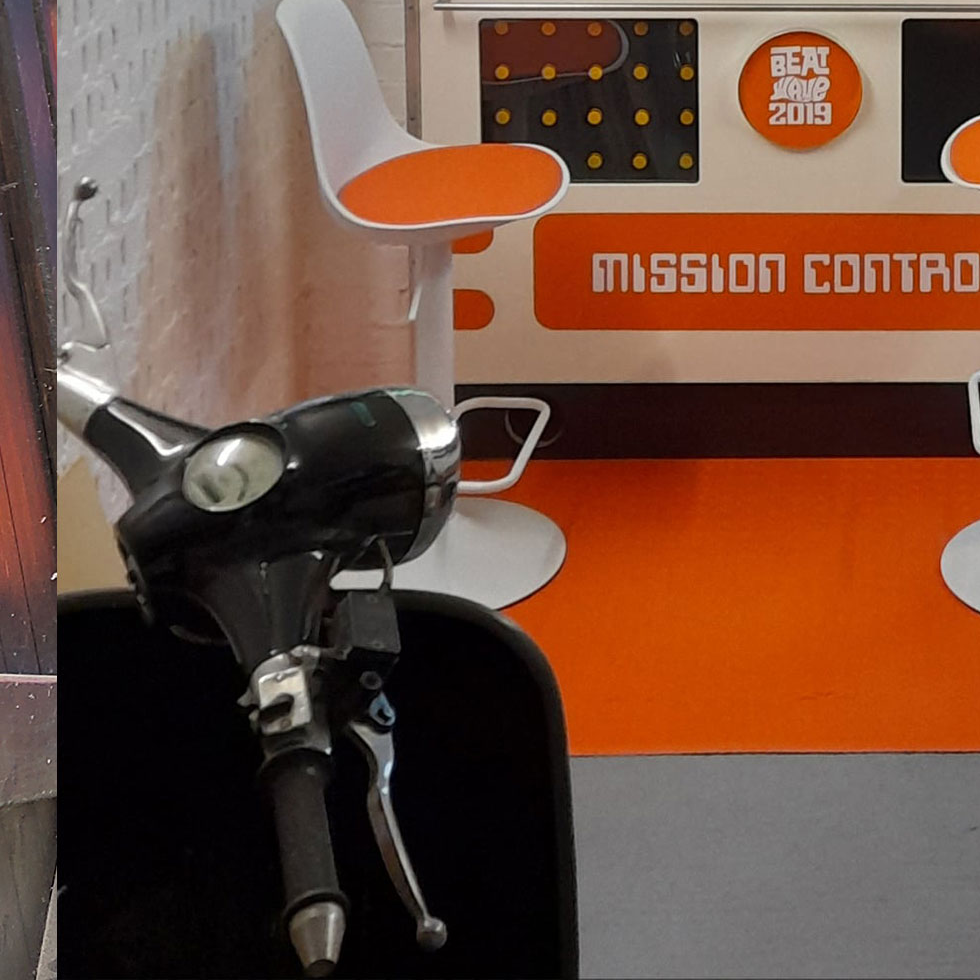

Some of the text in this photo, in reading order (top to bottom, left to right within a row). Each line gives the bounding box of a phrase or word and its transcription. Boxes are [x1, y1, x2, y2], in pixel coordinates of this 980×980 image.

[770, 46, 830, 77] BEAT
[768, 102, 832, 125] 2019
[592, 253, 786, 293] MISSION
